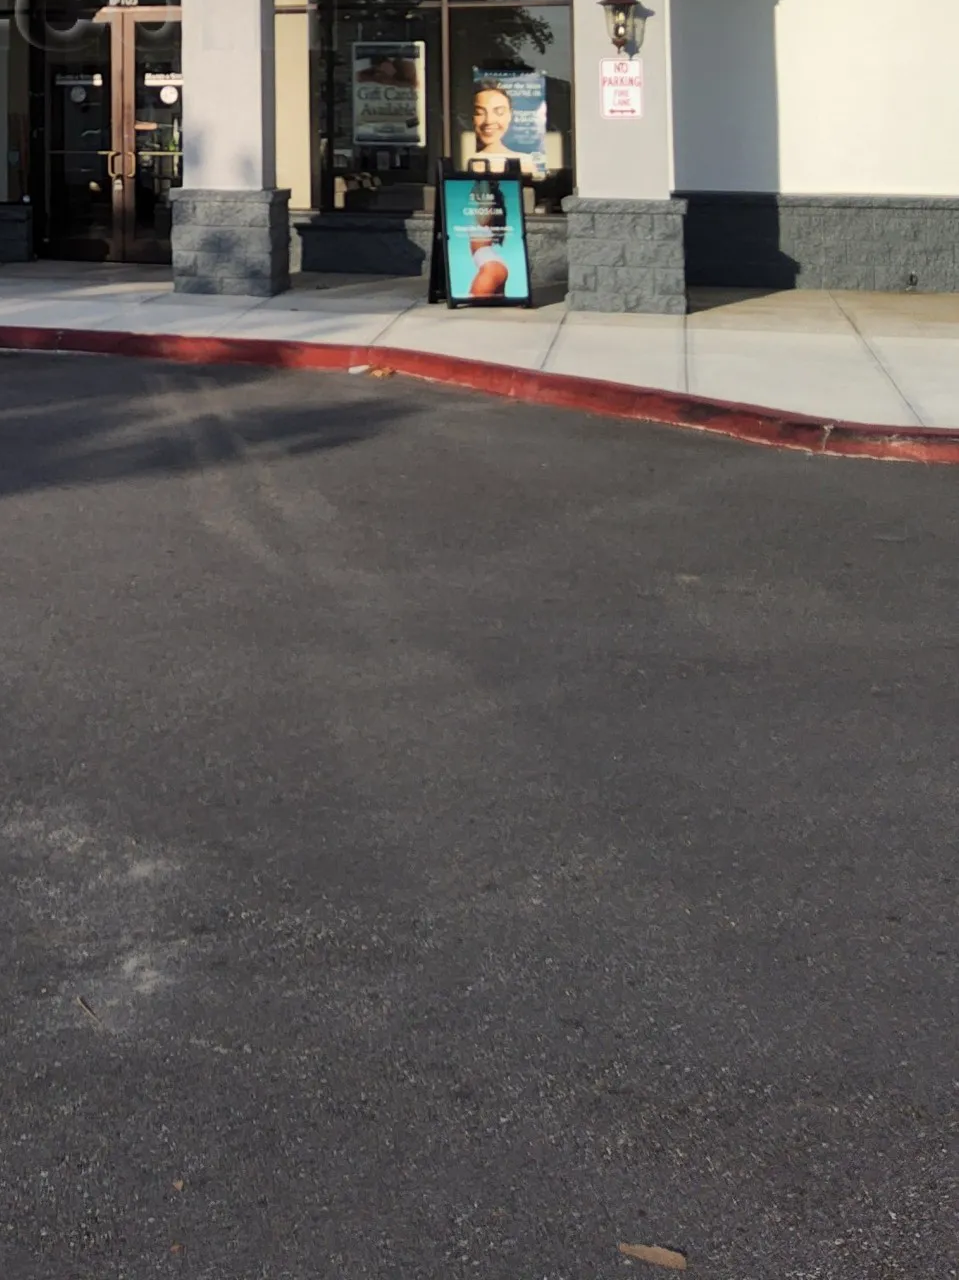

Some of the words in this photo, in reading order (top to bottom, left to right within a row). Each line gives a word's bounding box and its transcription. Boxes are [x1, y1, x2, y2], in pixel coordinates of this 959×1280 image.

[614, 62, 628, 73] NO
[602, 76, 642, 86] PARKING
[357, 86, 382, 100] Gift
